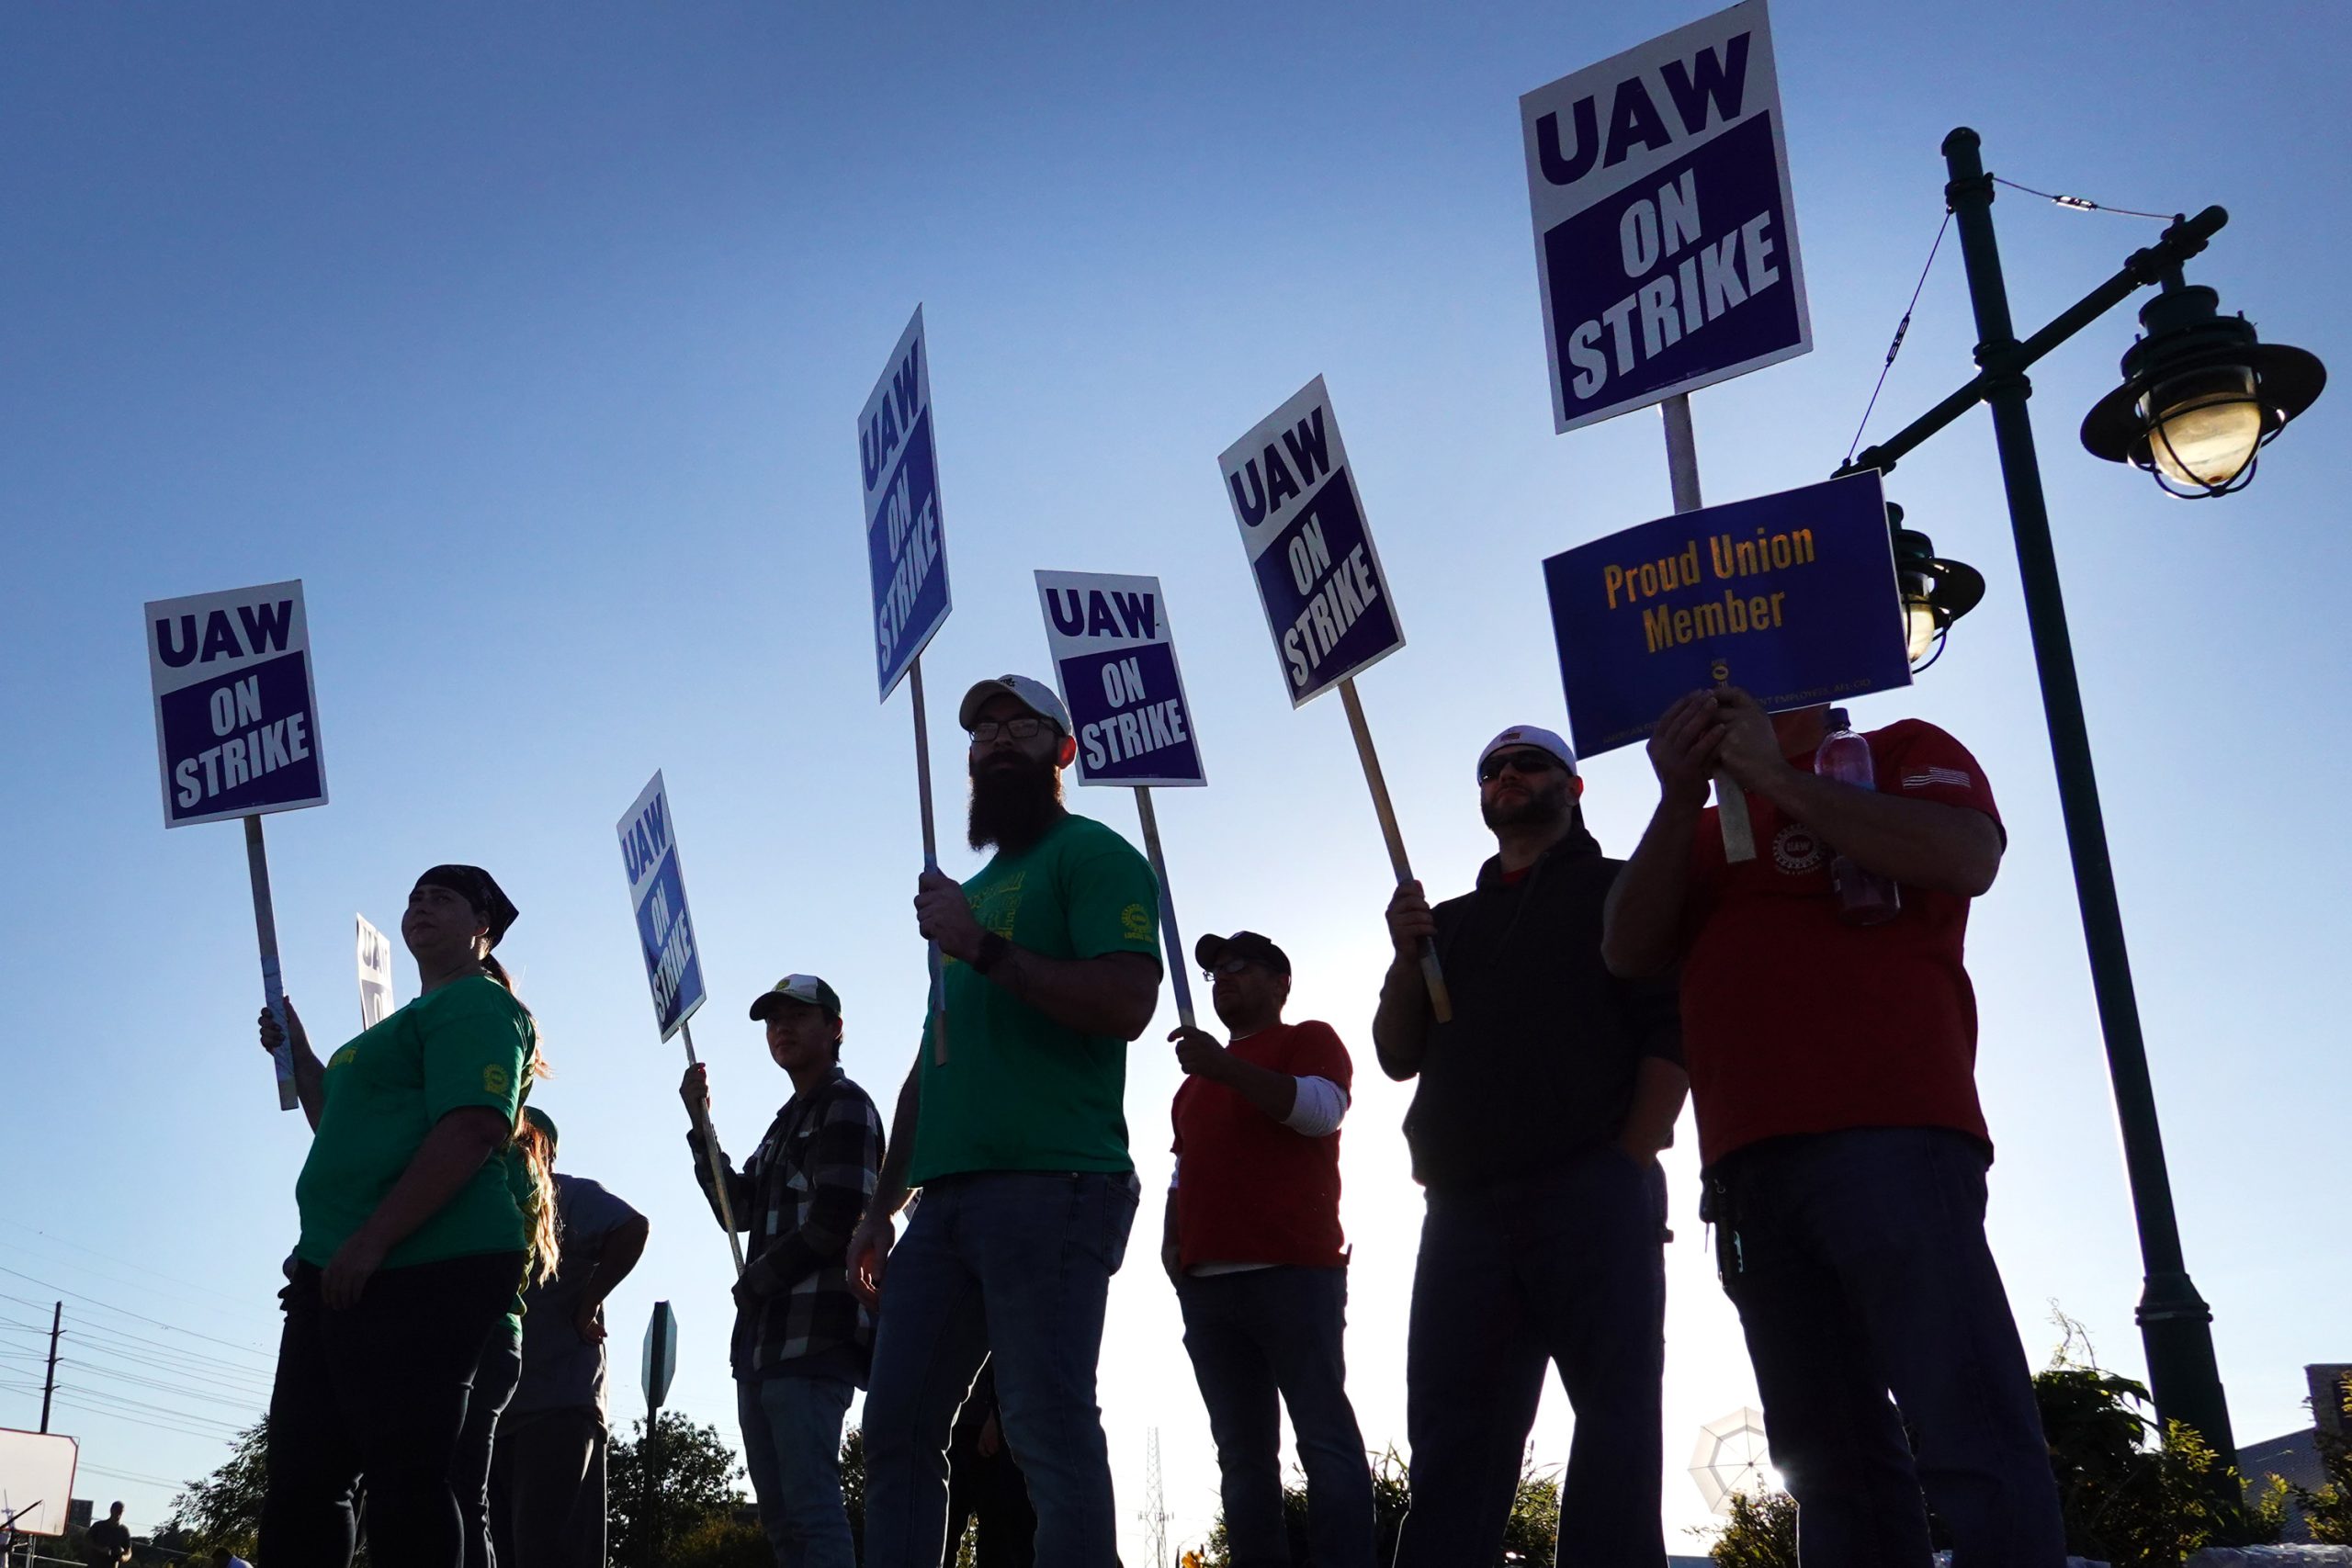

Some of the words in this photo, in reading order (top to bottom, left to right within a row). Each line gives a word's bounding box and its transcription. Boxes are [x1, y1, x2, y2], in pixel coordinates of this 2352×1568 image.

[1535, 30, 1751, 186] UAW
[1619, 167, 1702, 278] ON
[1567, 209, 1780, 400] STRIKE
[862, 337, 919, 491] UAW
[1229, 405, 1330, 527] UAW
[888, 464, 912, 564] ON
[1288, 512, 1331, 596] ON
[879, 491, 938, 672] STRIKE
[1046, 588, 1155, 639] UAW
[1283, 542, 1377, 687] STRIKE
[1603, 540, 1701, 610] Proud
[1710, 526, 1815, 580] Union
[155, 600, 293, 668] UAW
[1643, 589, 1785, 654] Member
[209, 674, 262, 737] ON
[1102, 656, 1146, 708] ON
[175, 711, 309, 808] STRIKE
[1081, 698, 1187, 771] STRIKE
[622, 792, 666, 886] UAW
[651, 878, 670, 947] ON
[652, 908, 692, 1023] STRIKE
